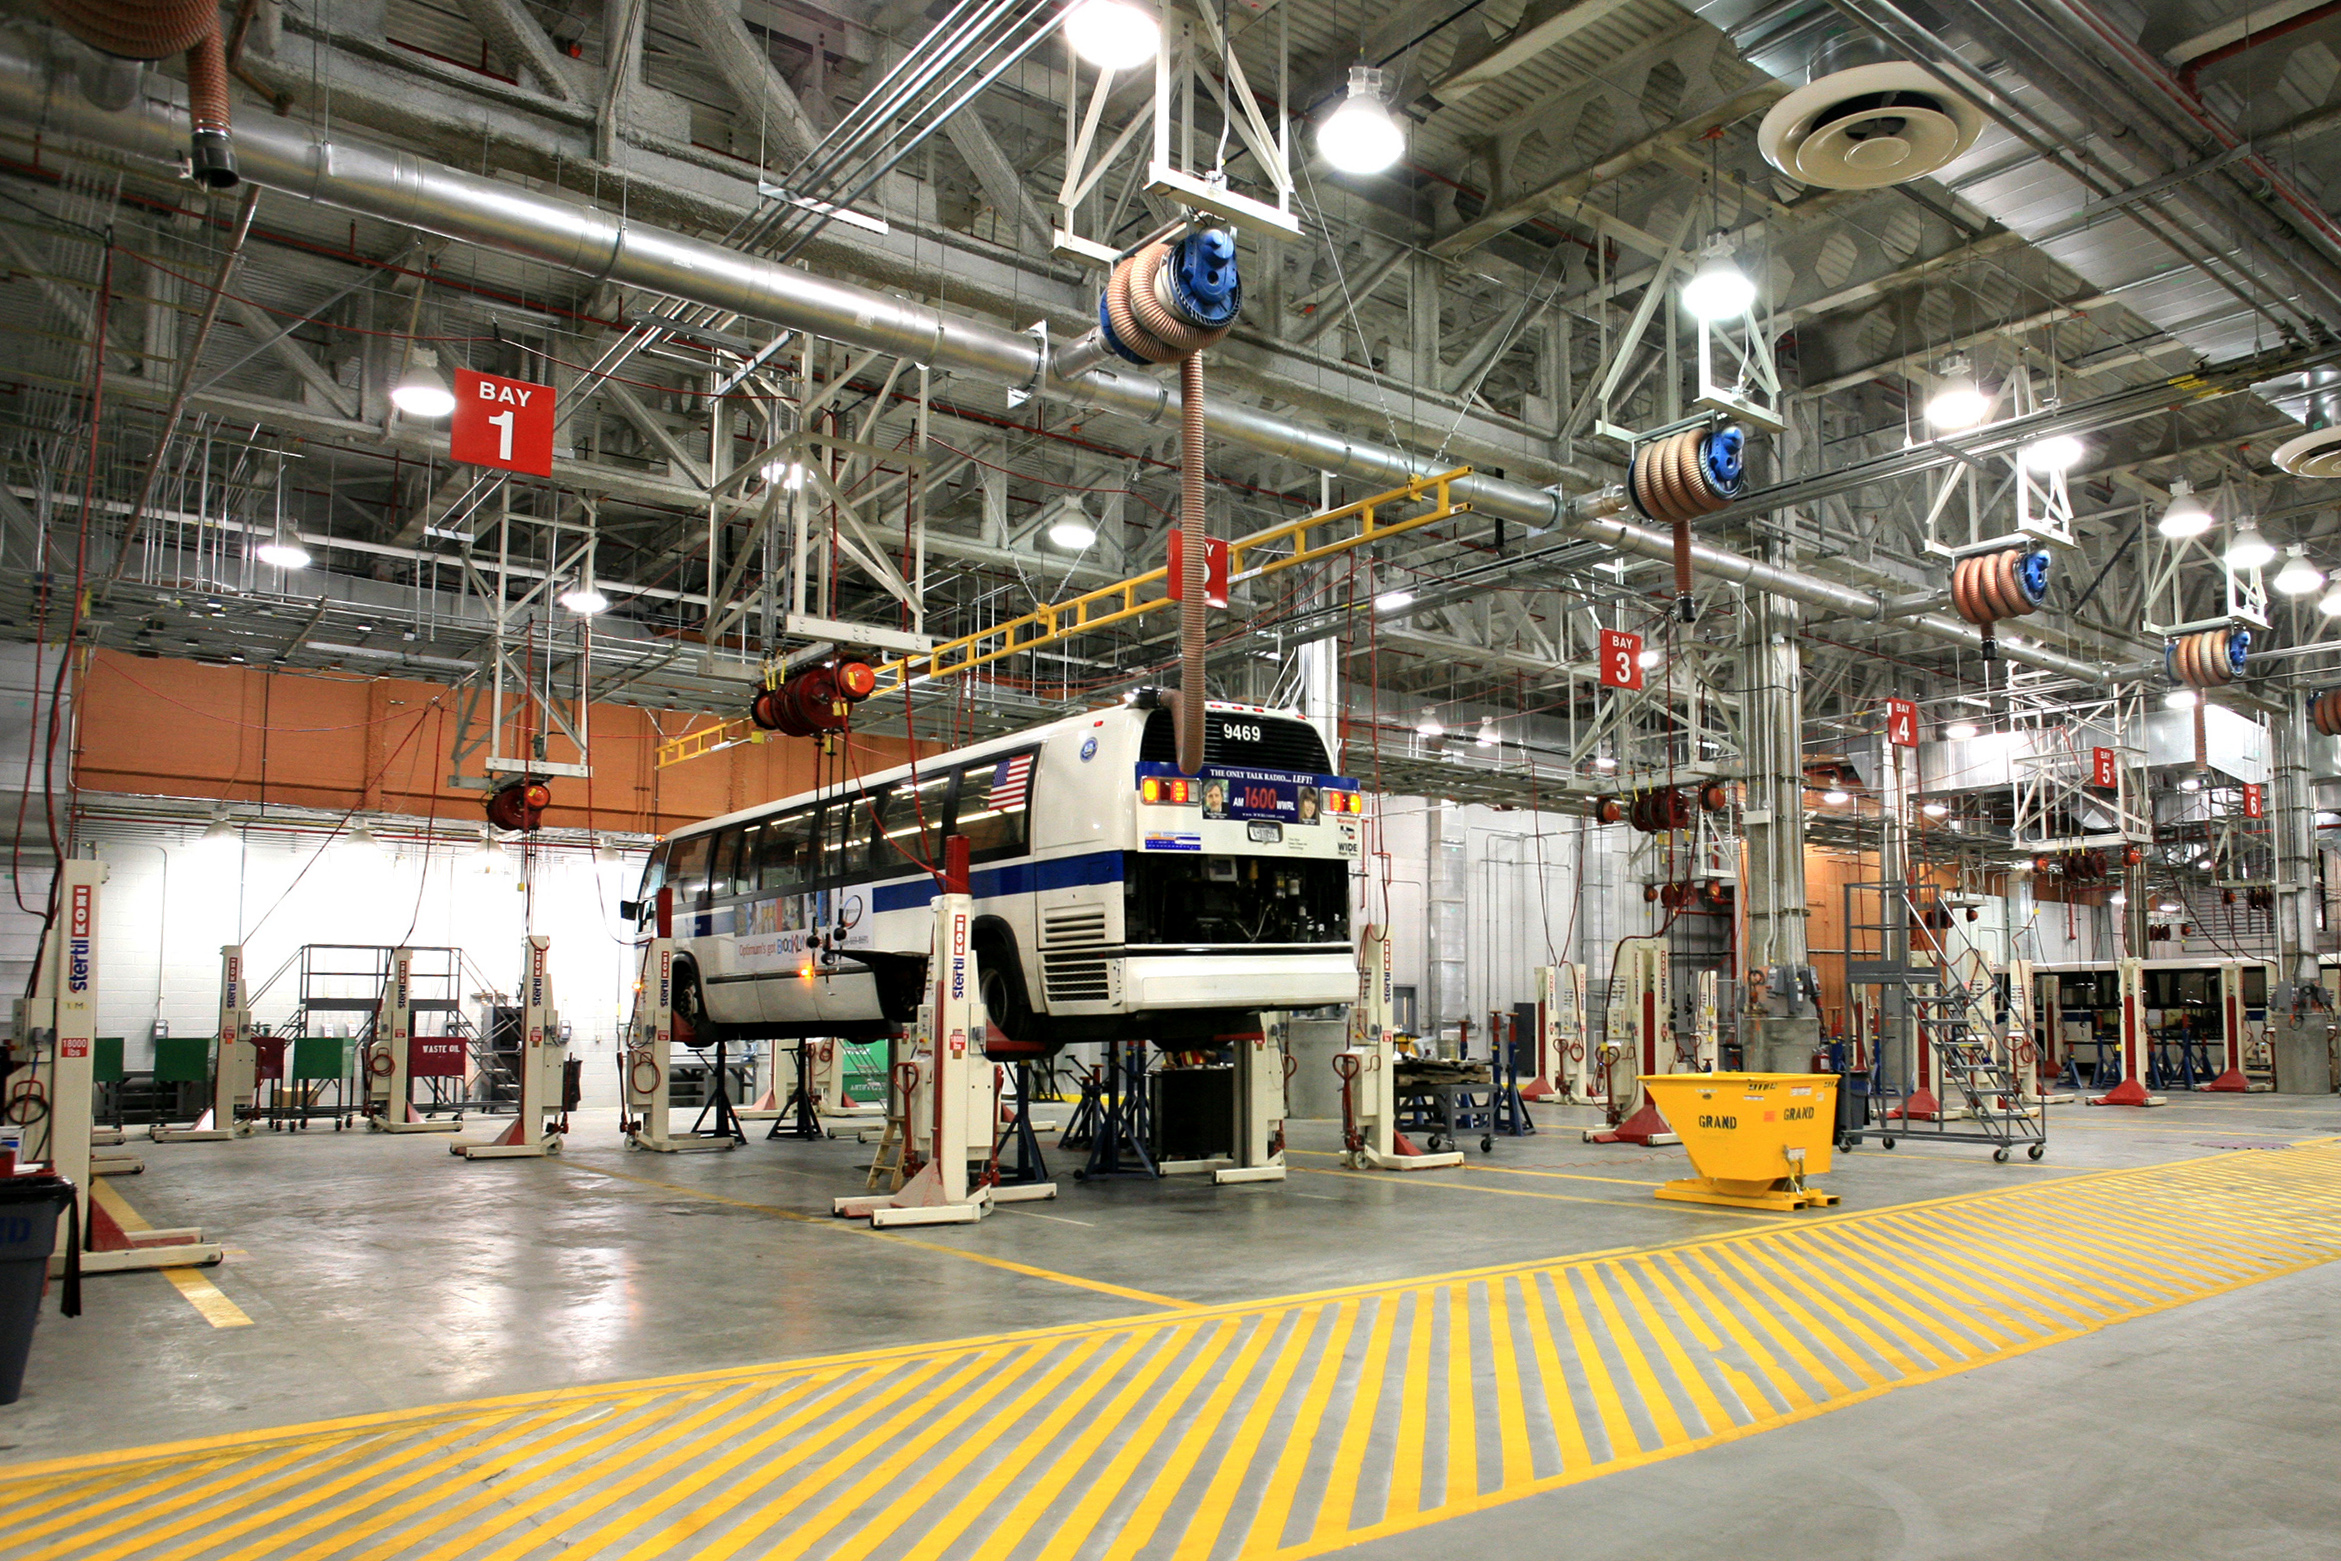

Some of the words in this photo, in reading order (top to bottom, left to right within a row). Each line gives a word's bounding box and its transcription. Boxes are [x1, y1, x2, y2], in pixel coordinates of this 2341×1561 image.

[479, 381, 532, 407] BAY
[488, 410, 514, 461] 1
[1612, 635, 1633, 649] BAY
[1615, 651, 1631, 683] 3
[1896, 702, 1911, 714] BAY
[1223, 723, 1261, 741] 9469
[1899, 716, 1910, 741] 4
[1210, 768, 1225, 777] THE
[1226, 770, 1245, 779] ONLY
[1246, 772, 1263, 780] TALK
[1292, 774, 1313, 784] LEFT!
[2102, 762, 2111, 784] 5
[1233, 797, 1244, 807] AM
[1244, 786, 1277, 810] 1600
[1276, 800, 1296, 811] WWRL
[2250, 796, 2258, 815] 6
[1337, 842, 1358, 853] WIDE
[74, 887, 88, 936] KONI
[955, 916, 964, 954] KONI
[69, 940, 90, 993] stertil
[952, 957, 965, 1000] stertil
[63, 1040, 87, 1048] 18000
[67, 1048, 81, 1057] lbs
[422, 1045, 447, 1053] WASTE
[1699, 1115, 1737, 1130] GRAND
[1784, 1107, 1815, 1121] GRAND
